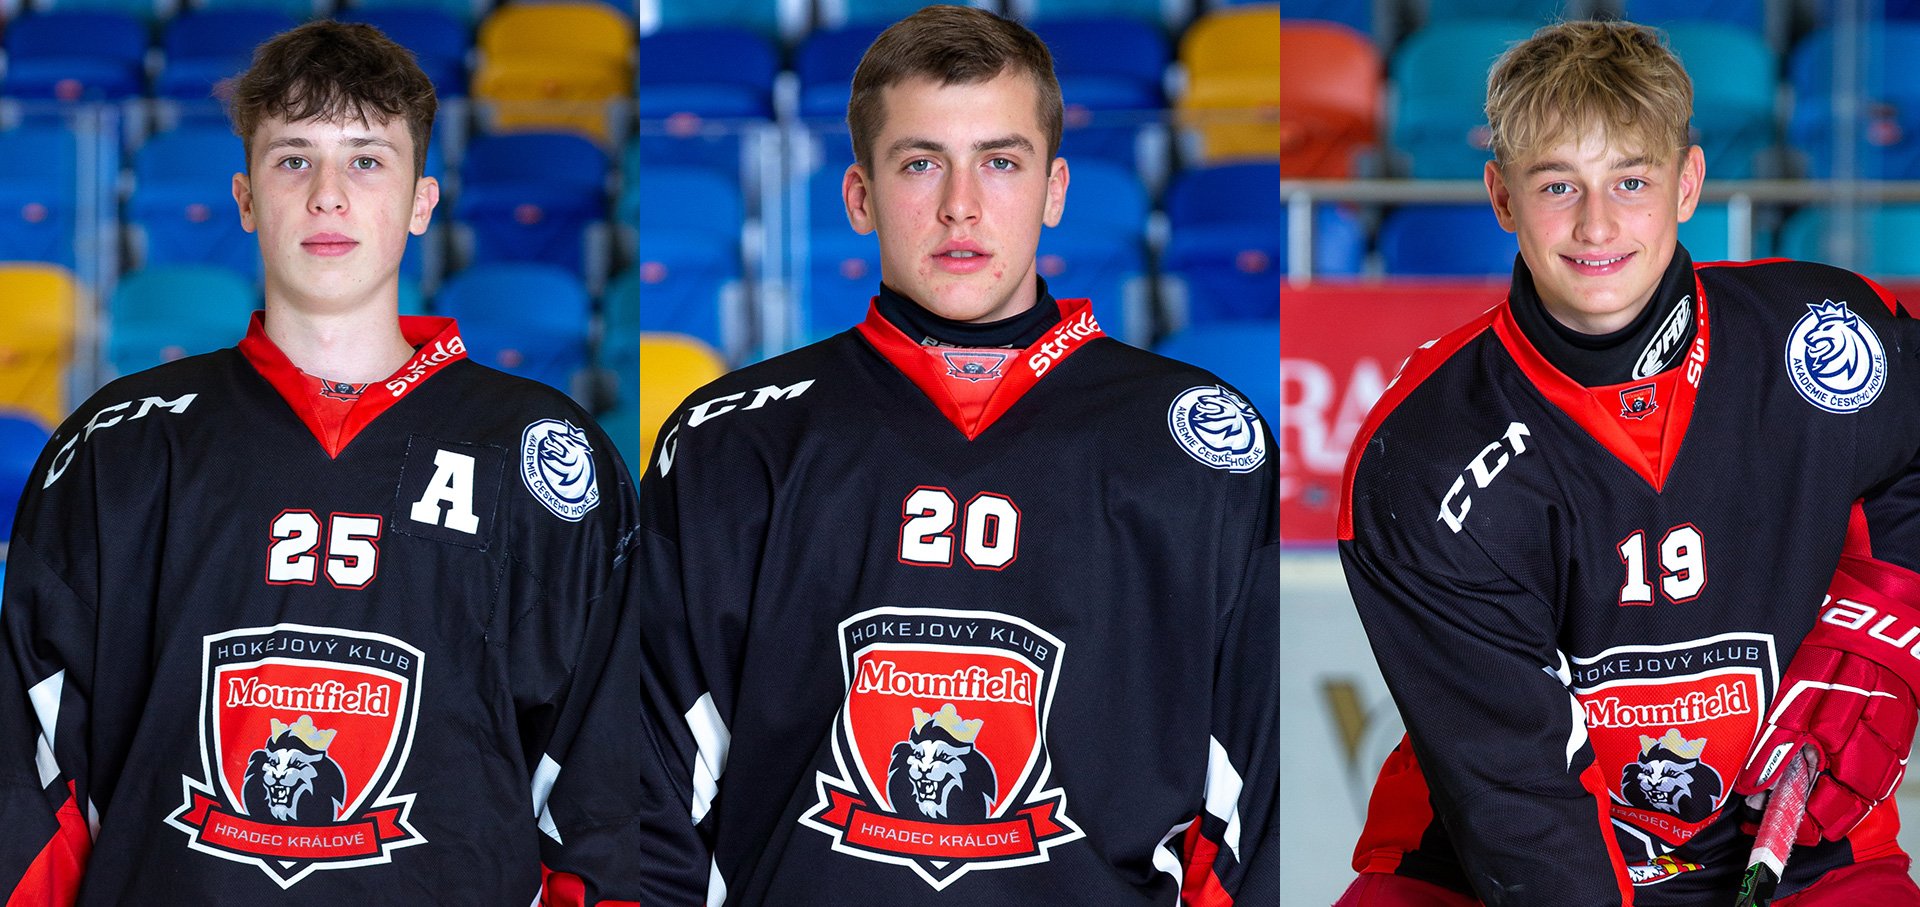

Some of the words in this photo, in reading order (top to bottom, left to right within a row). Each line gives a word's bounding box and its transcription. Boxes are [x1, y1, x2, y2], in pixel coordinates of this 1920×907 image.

[1793, 357, 1828, 403] AKADEMIE
[1868, 353, 1883, 393] HOKEJE
[42, 394, 199, 490] CCM
[656, 379, 816, 478] CCM
[1175, 406, 1199, 448] AKADEMIE
[1230, 447, 1264, 467] HOKEJE
[410, 449, 480, 535] A
[533, 480, 569, 515] ČESKÉHO
[265, 509, 382, 590] 25
[898, 485, 1021, 571] 20
[1616, 522, 1707, 606] 19
[218, 637, 339, 660] HOKEJOVÝ
[349, 644, 411, 671] KLUB
[851, 621, 979, 645] HOKEJOVÝ
[989, 626, 1049, 662] KLUB
[1573, 652, 1693, 684] HOKEJOVÝ
[1702, 646, 1760, 665] KLUB
[226, 676, 391, 717] Mountfield
[856, 659, 1033, 706] Mountfield
[1584, 680, 1751, 729] Mountfield
[215, 822, 283, 846] HRADEC
[287, 831, 365, 848] KRÁLOVÉ
[861, 822, 934, 845] HRADEC
[939, 829, 1021, 847] KRÁLOVÉ
